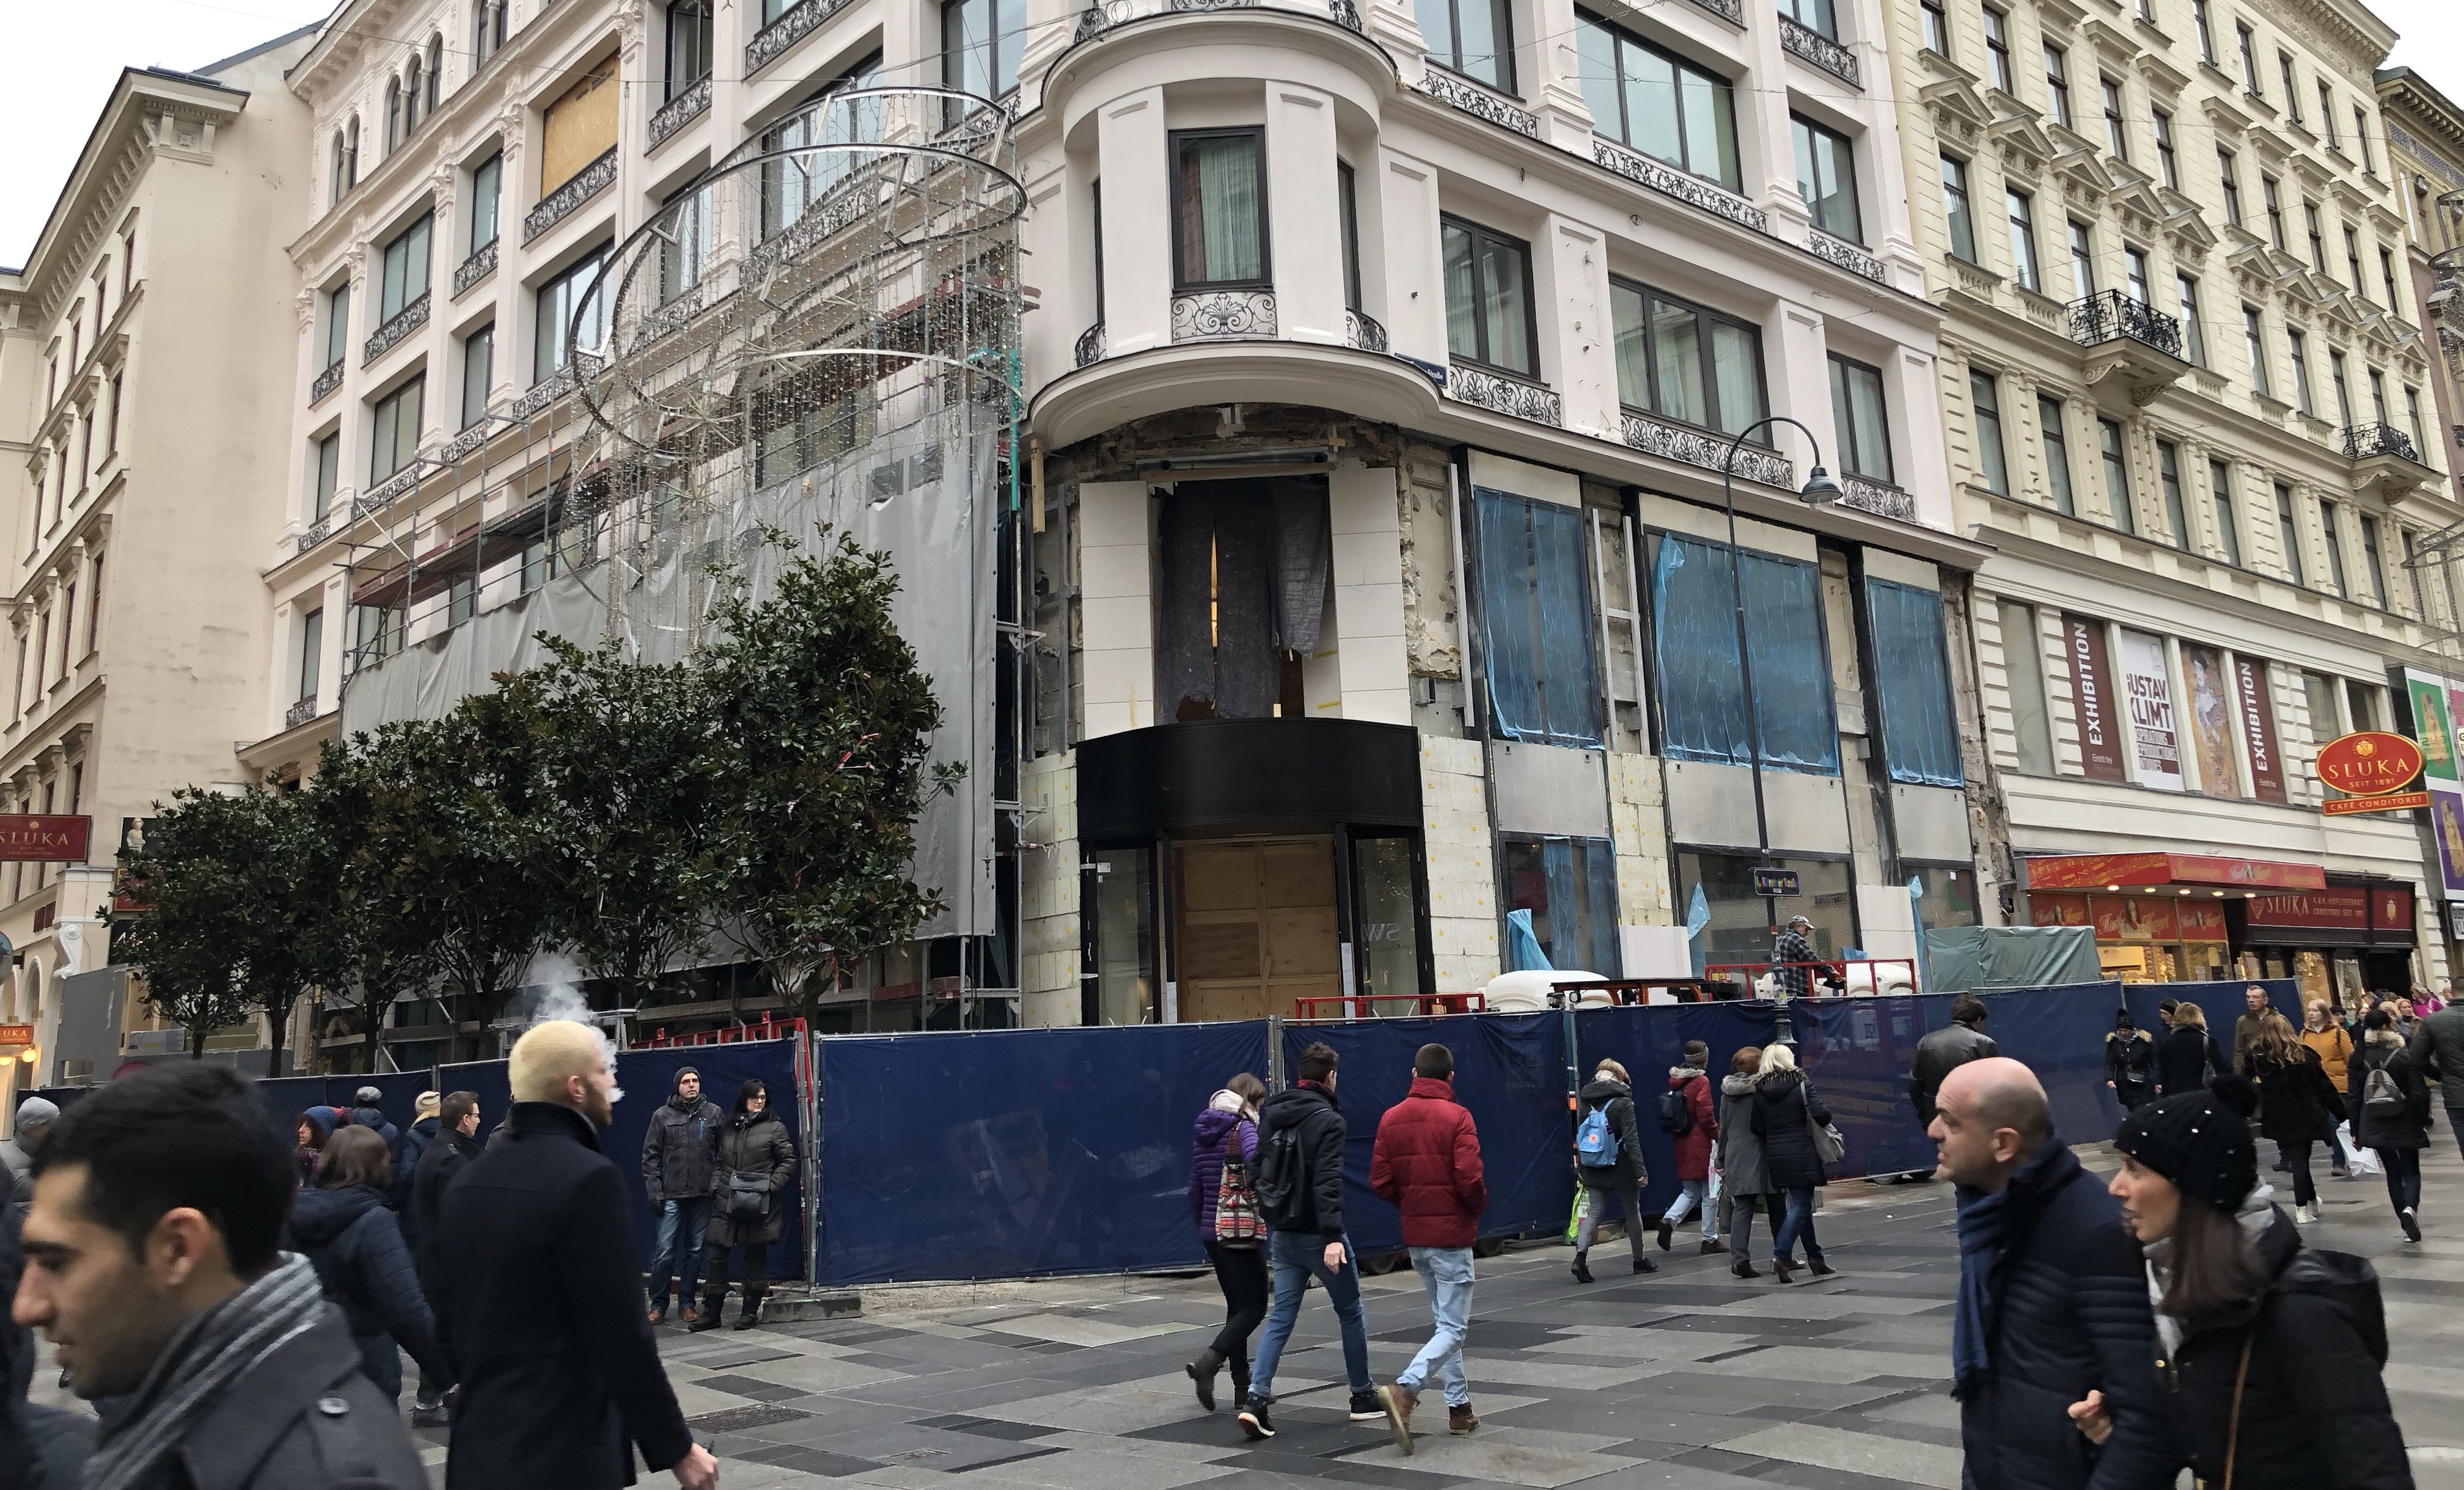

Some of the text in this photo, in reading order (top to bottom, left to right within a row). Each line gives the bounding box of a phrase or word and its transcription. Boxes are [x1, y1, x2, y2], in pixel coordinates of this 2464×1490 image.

[1428, 368, 1443, 381] Straße
[2073, 623, 2103, 746] EXHIBITION
[2240, 662, 2268, 772] EXHIBITION
[2328, 758, 2410, 780] SLUKA
[2375, 778, 2395, 786] 1891
[2330, 796, 2422, 811] CAFÉ CONDITOREI
[2267, 894, 2309, 917] SLUKA
